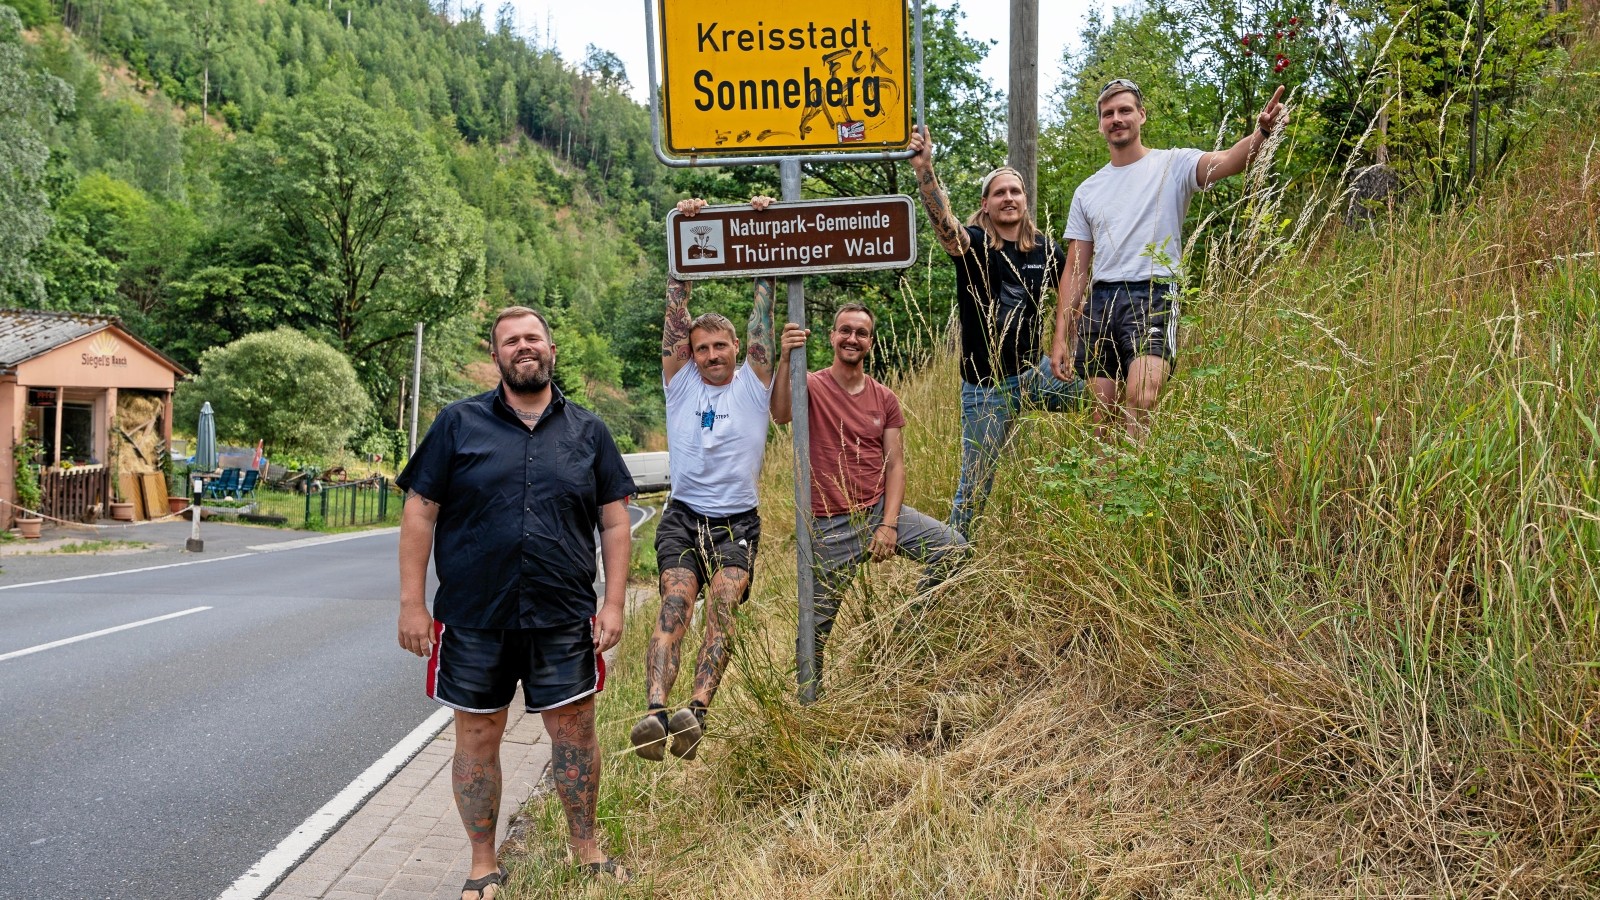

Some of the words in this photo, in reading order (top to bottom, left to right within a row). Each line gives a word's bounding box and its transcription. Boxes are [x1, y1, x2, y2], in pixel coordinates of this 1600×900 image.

[697, 19, 872, 52] Kreisstadt
[693, 67, 881, 117] Sonneberg
[729, 211, 890, 238] Naturpark-Gemeinde
[731, 242, 833, 264] Thüringer
[844, 237, 894, 257] Wald
